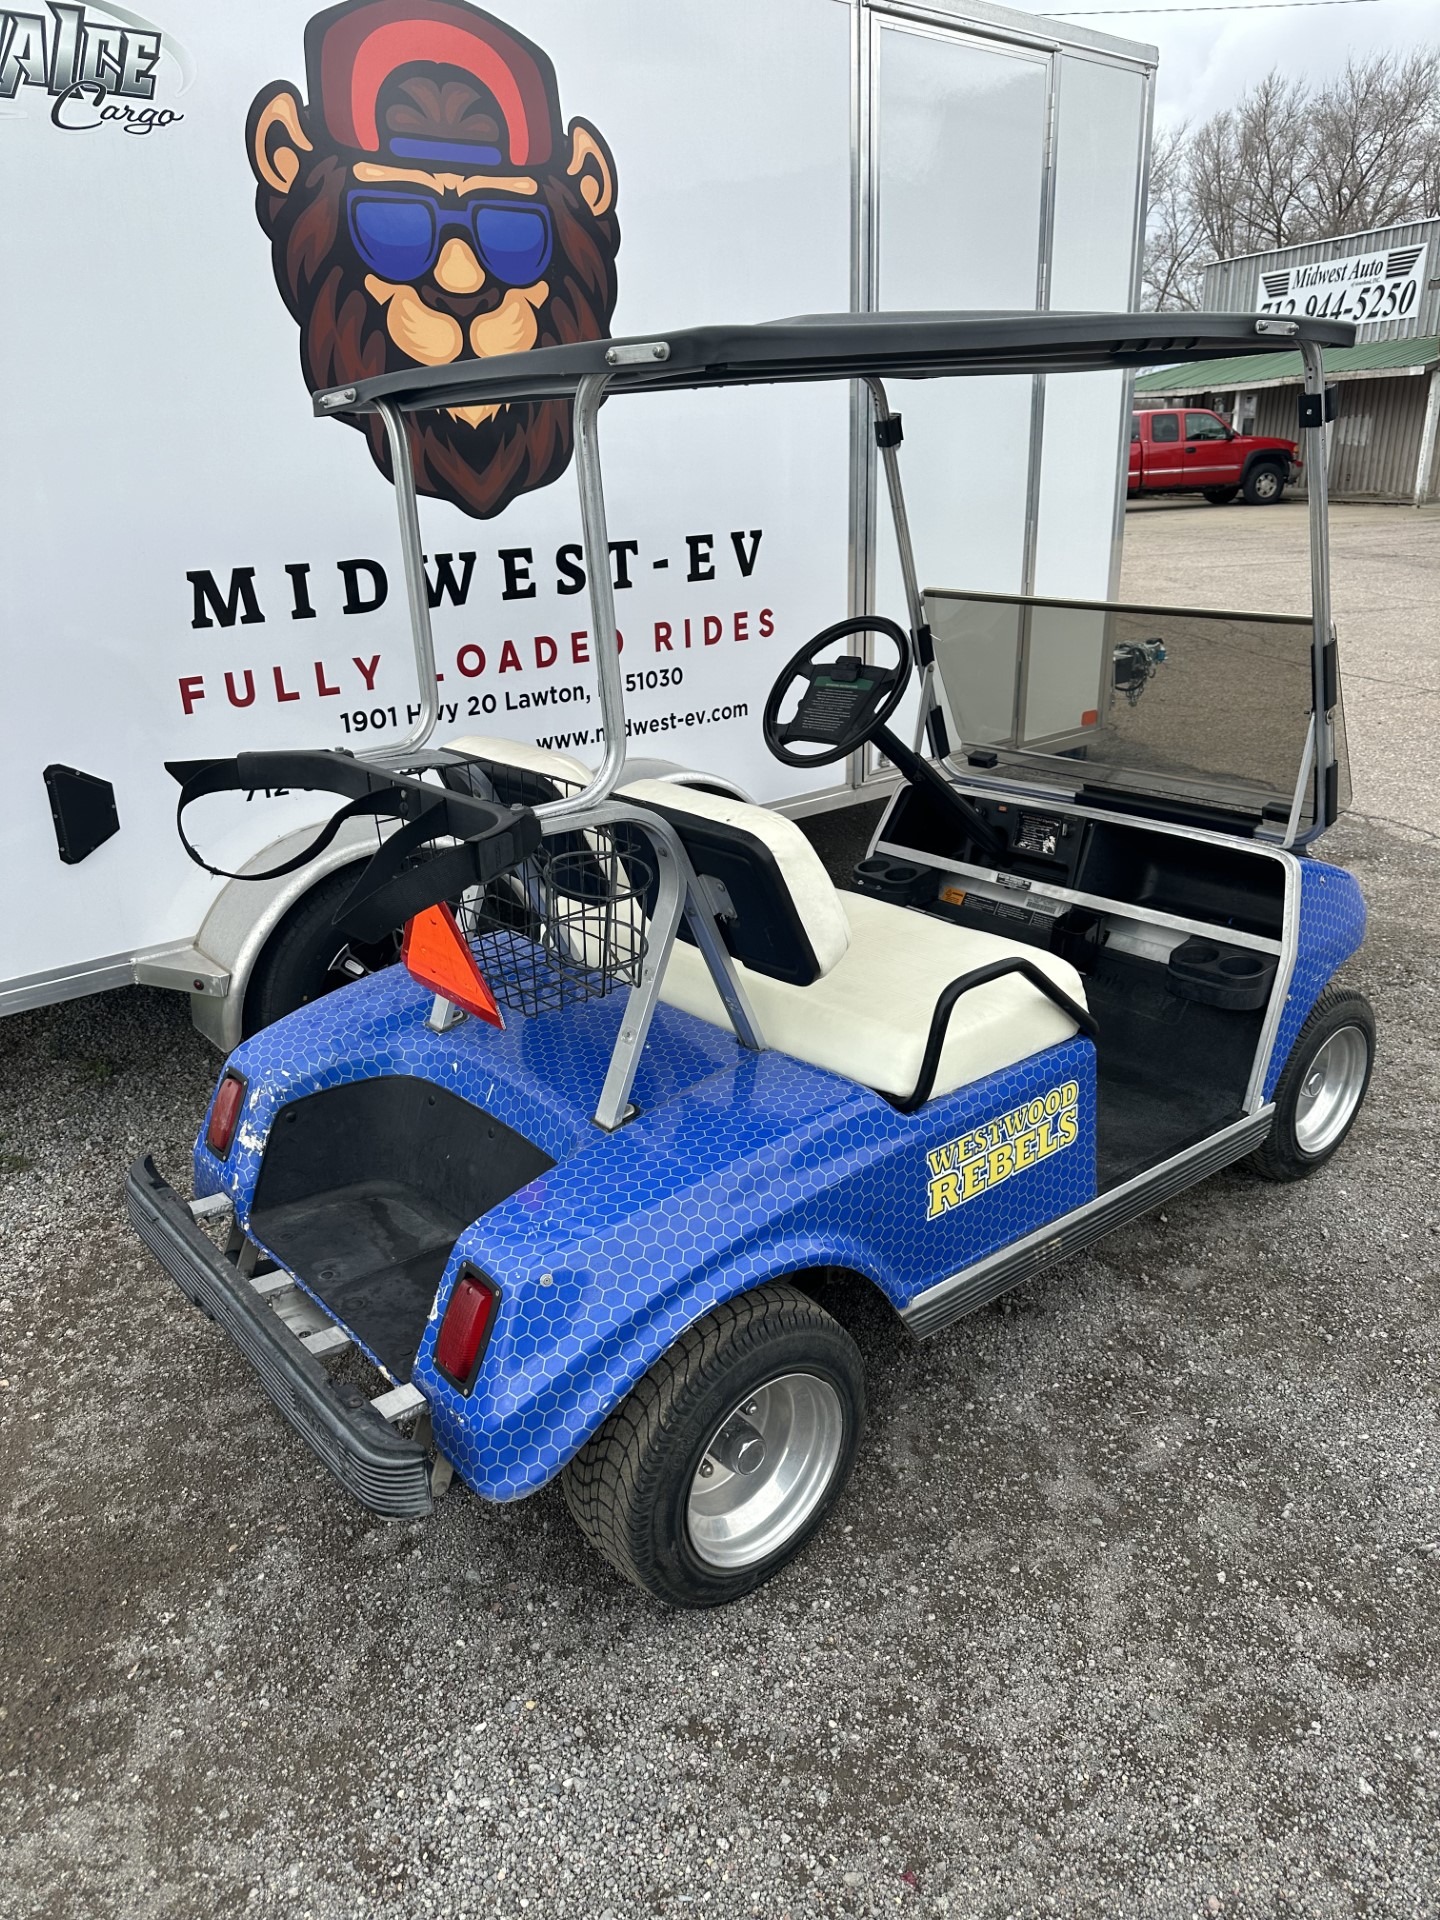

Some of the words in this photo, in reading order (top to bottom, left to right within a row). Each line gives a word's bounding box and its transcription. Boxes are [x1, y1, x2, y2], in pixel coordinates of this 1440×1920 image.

[51, 80, 184, 135] Cargo
[1292, 263, 1348, 290] Midwest
[1348, 259, 1384, 282] Auto
[186, 530, 763, 629] MIDWEST-EV
[178, 654, 382, 715] FULLY
[436, 628, 624, 682] OADE
[654, 608, 775, 653] RIDES
[339, 706, 398, 734] 1901
[467, 693, 497, 717] 20
[505, 684, 591, 712] Lawton,
[625, 667, 684, 692] 51030
[927, 1105, 1079, 1221] REBELS
[928, 1080, 1079, 1177] WESTWOOD
